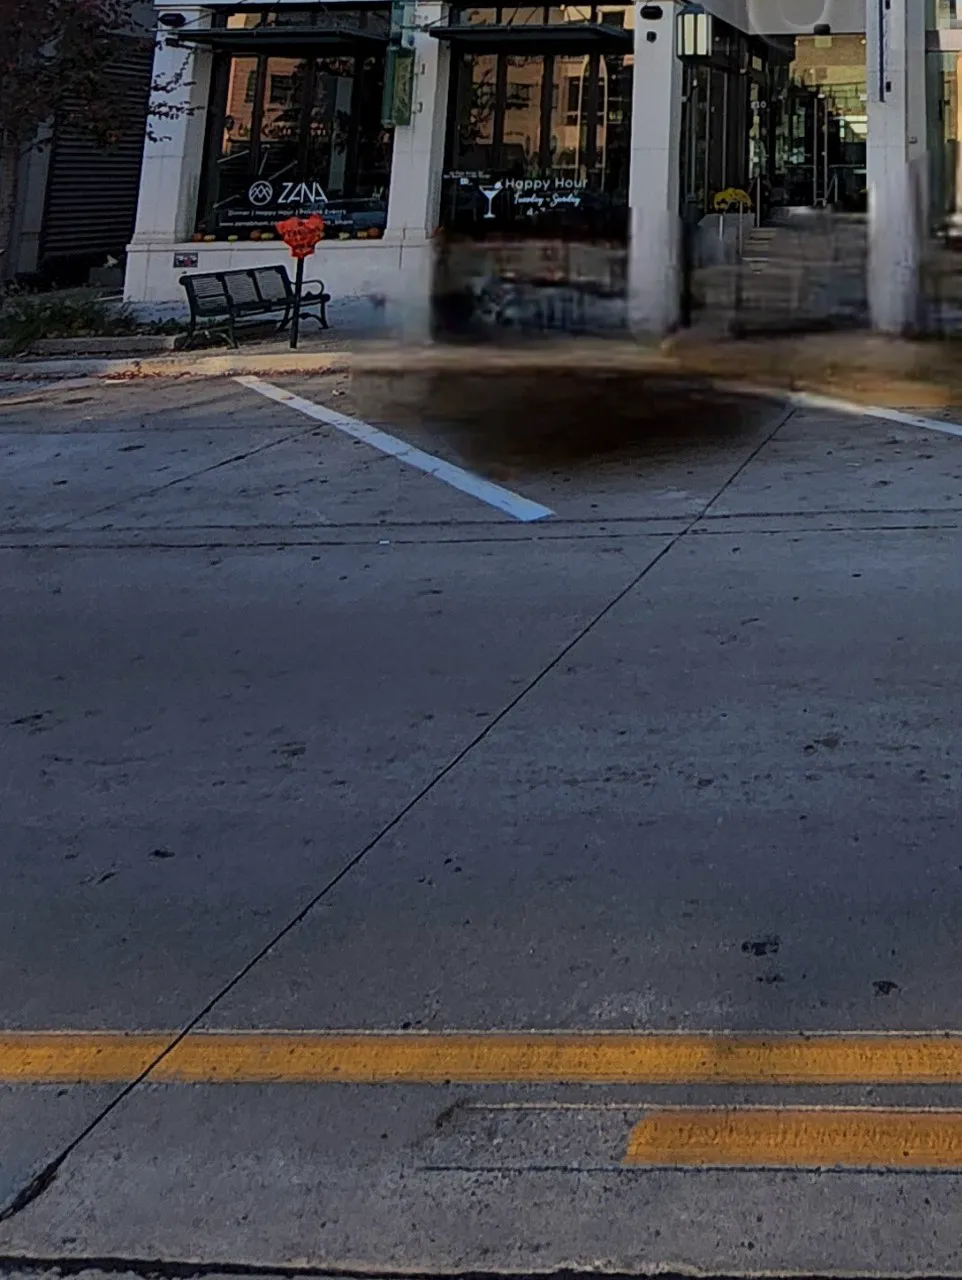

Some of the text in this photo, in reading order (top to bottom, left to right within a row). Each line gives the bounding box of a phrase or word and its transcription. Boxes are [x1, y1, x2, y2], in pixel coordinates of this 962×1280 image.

[277, 182, 328, 203] ZANA
[505, 177, 588, 191] Happy Hour
